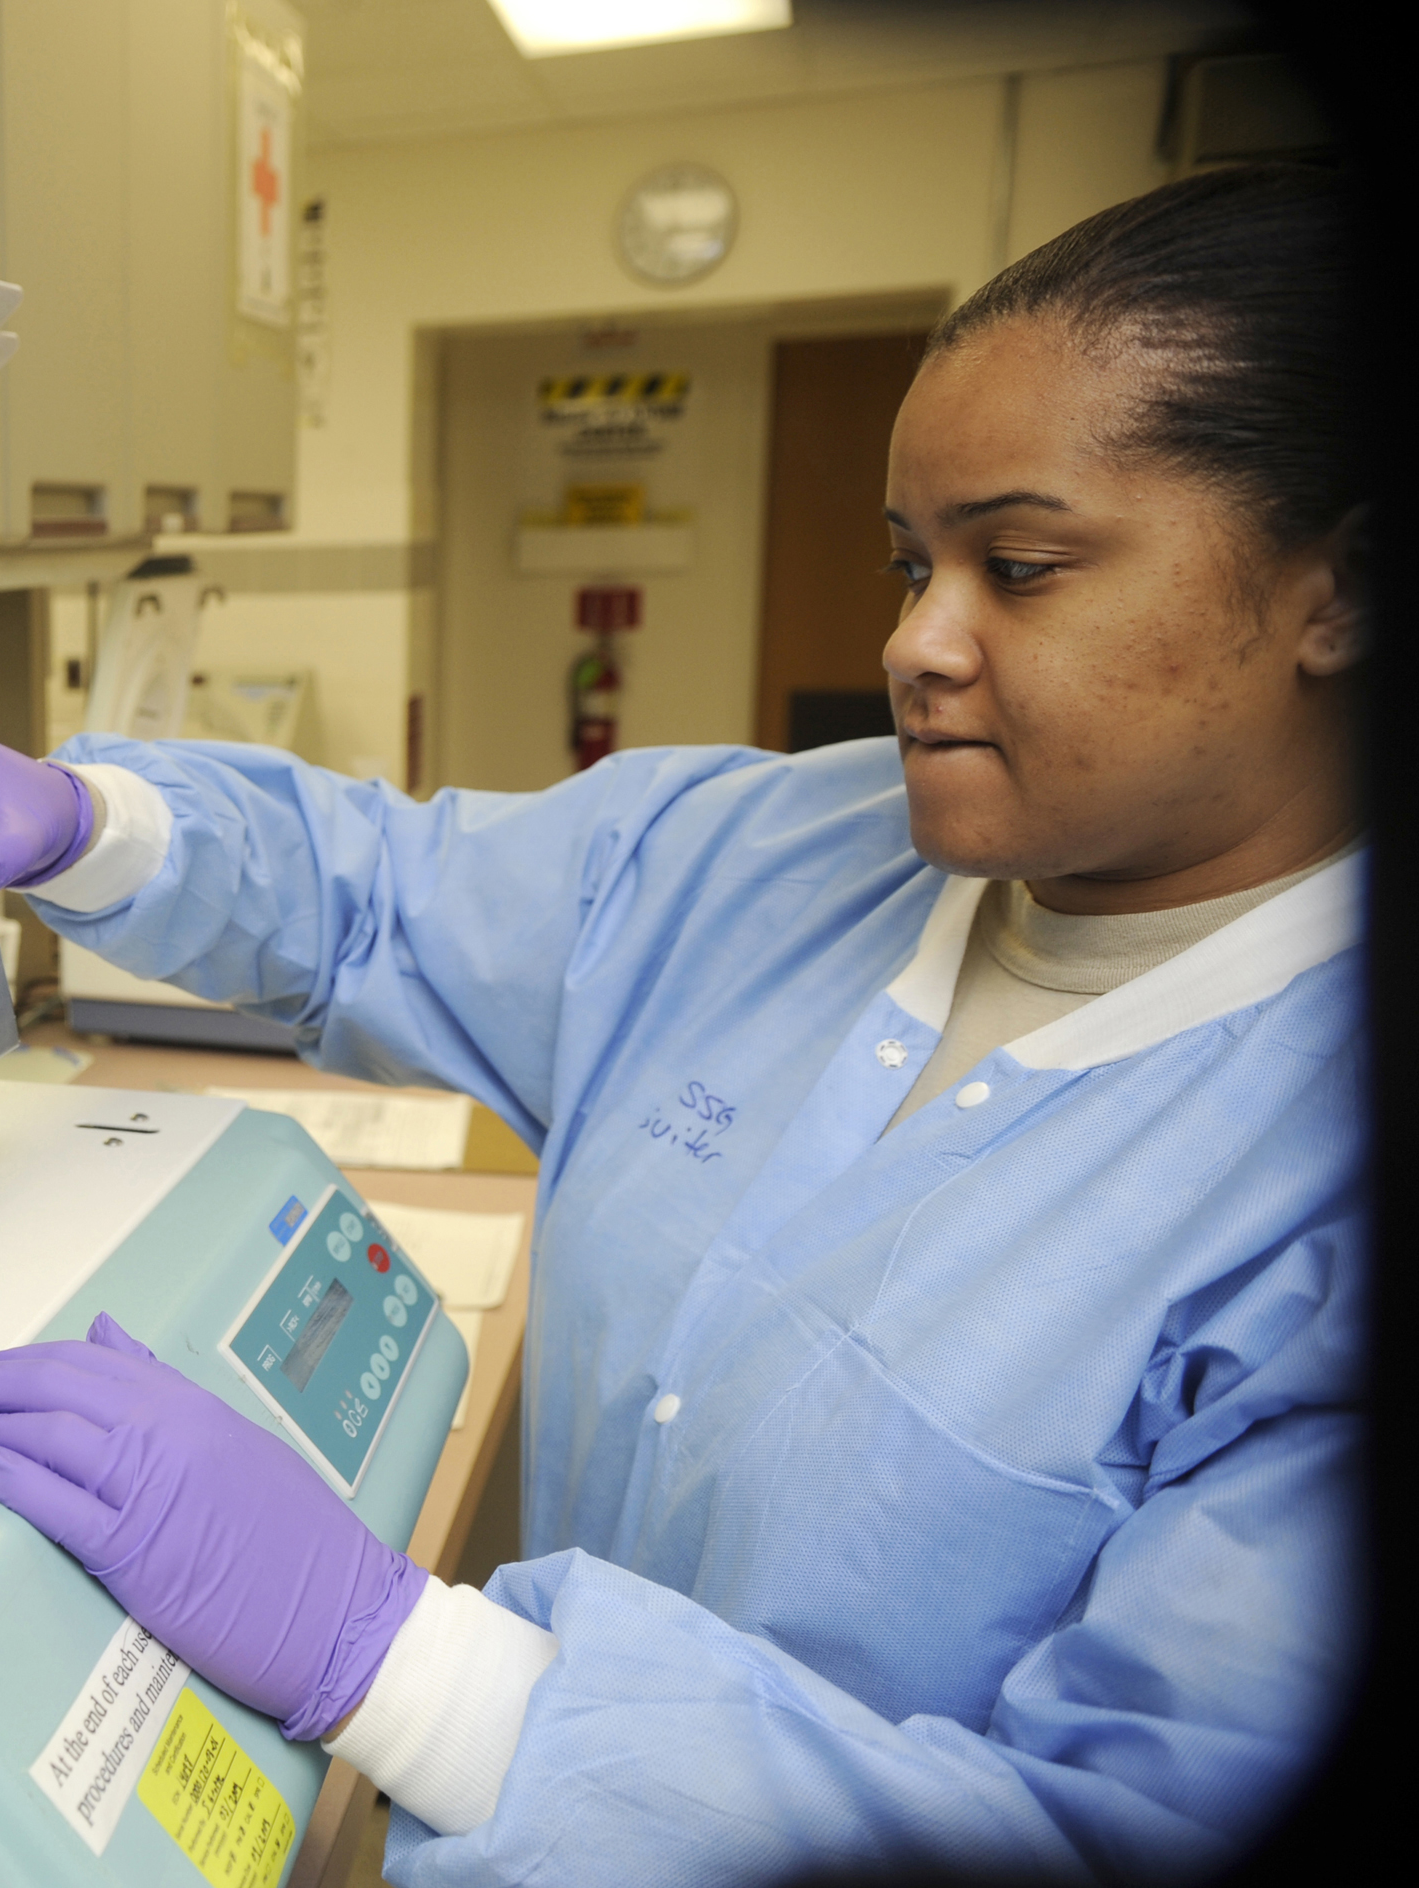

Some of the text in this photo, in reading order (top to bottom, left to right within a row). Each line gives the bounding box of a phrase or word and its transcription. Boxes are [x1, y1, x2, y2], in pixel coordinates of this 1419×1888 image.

[679, 1081, 736, 1136] SSG
[262, 1354, 275, 1371] PROG
[50, 1756, 73, 1788] At
[64, 1731, 88, 1762] the
[84, 1696, 107, 1734] end
[102, 1675, 119, 1704] of
[113, 1648, 139, 1686] each
[152, 1714, 183, 1775] Scheduled Maintenance
[77, 1727, 134, 1827] procedures
[130, 1693, 150, 1733] and
[169, 1732, 186, 1764] Certification
